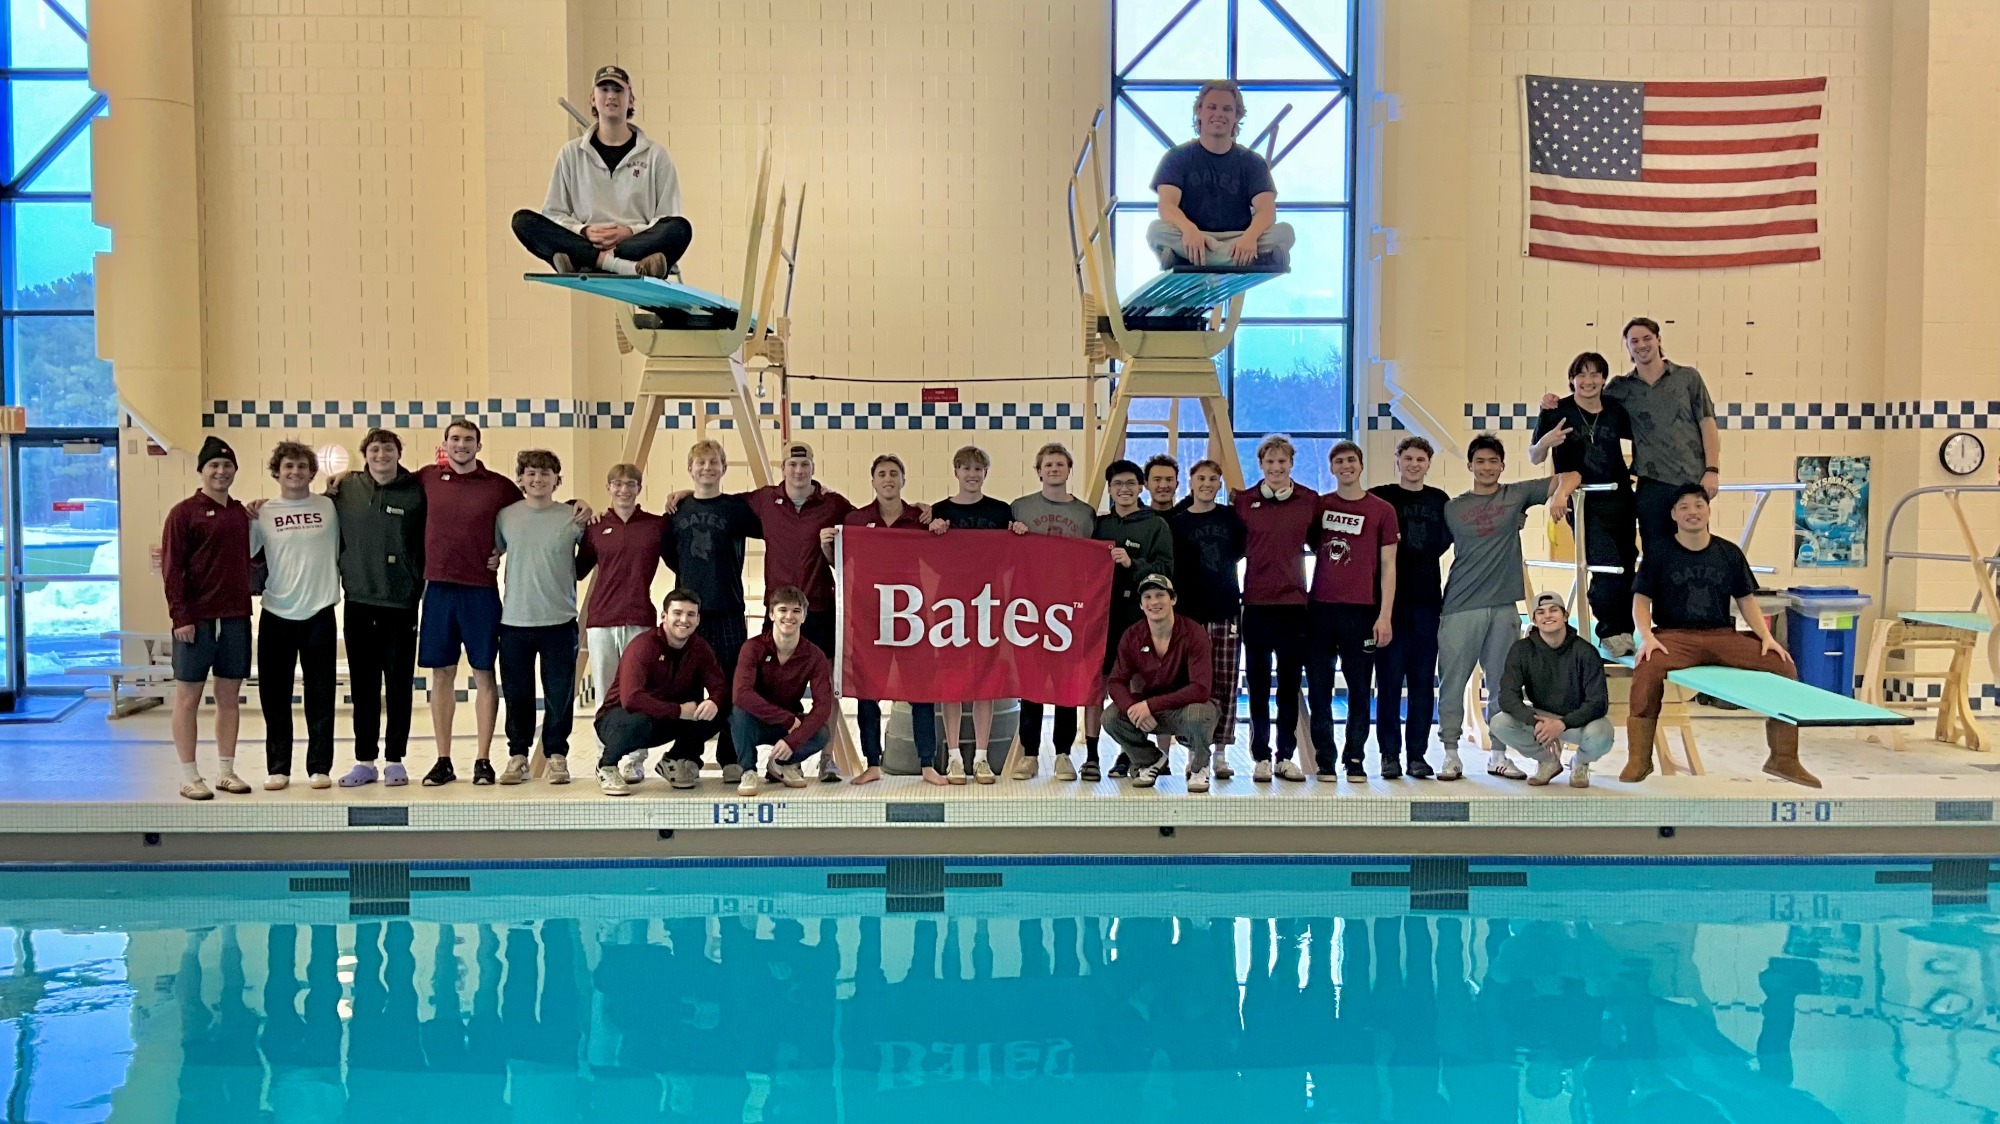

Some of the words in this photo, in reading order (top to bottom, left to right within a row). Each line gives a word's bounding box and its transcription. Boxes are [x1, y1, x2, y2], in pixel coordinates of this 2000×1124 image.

[274, 513, 323, 527] BATES
[1033, 513, 1079, 533] BOBCATS
[1326, 513, 1360, 526] BATES
[873, 583, 1074, 652] Bates
